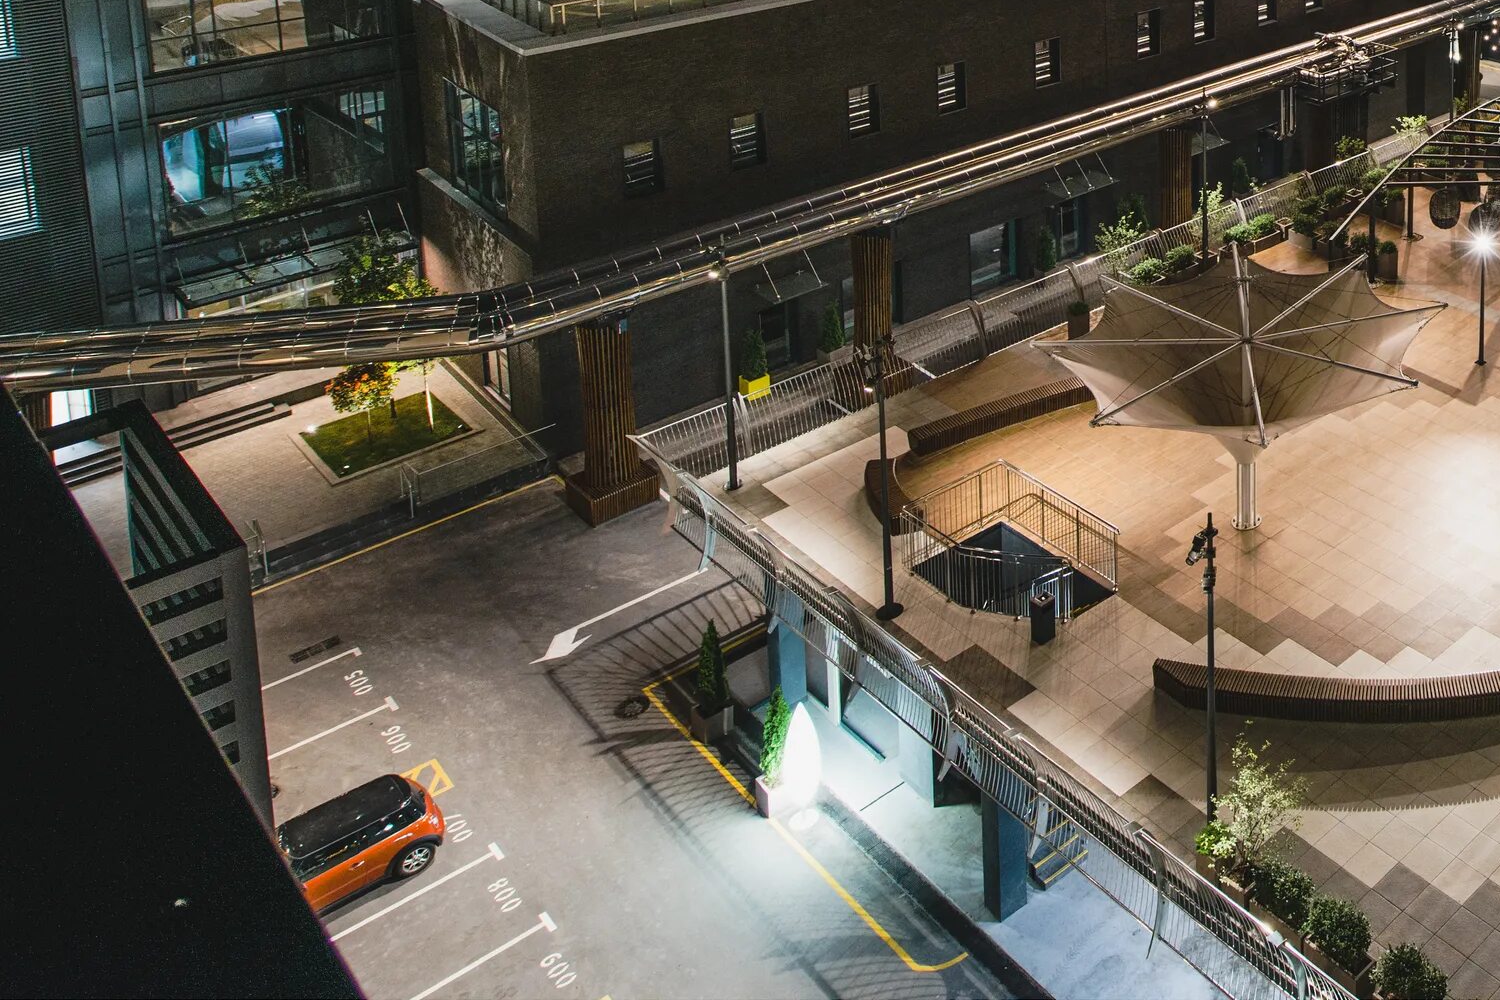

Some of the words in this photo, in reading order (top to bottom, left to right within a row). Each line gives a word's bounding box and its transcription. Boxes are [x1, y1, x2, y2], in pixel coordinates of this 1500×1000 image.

[343, 669, 374, 696] 005
[380, 725, 412, 754] 006
[443, 813, 474, 843] 007
[487, 877, 523, 913] 008
[539, 952, 578, 989] 009
